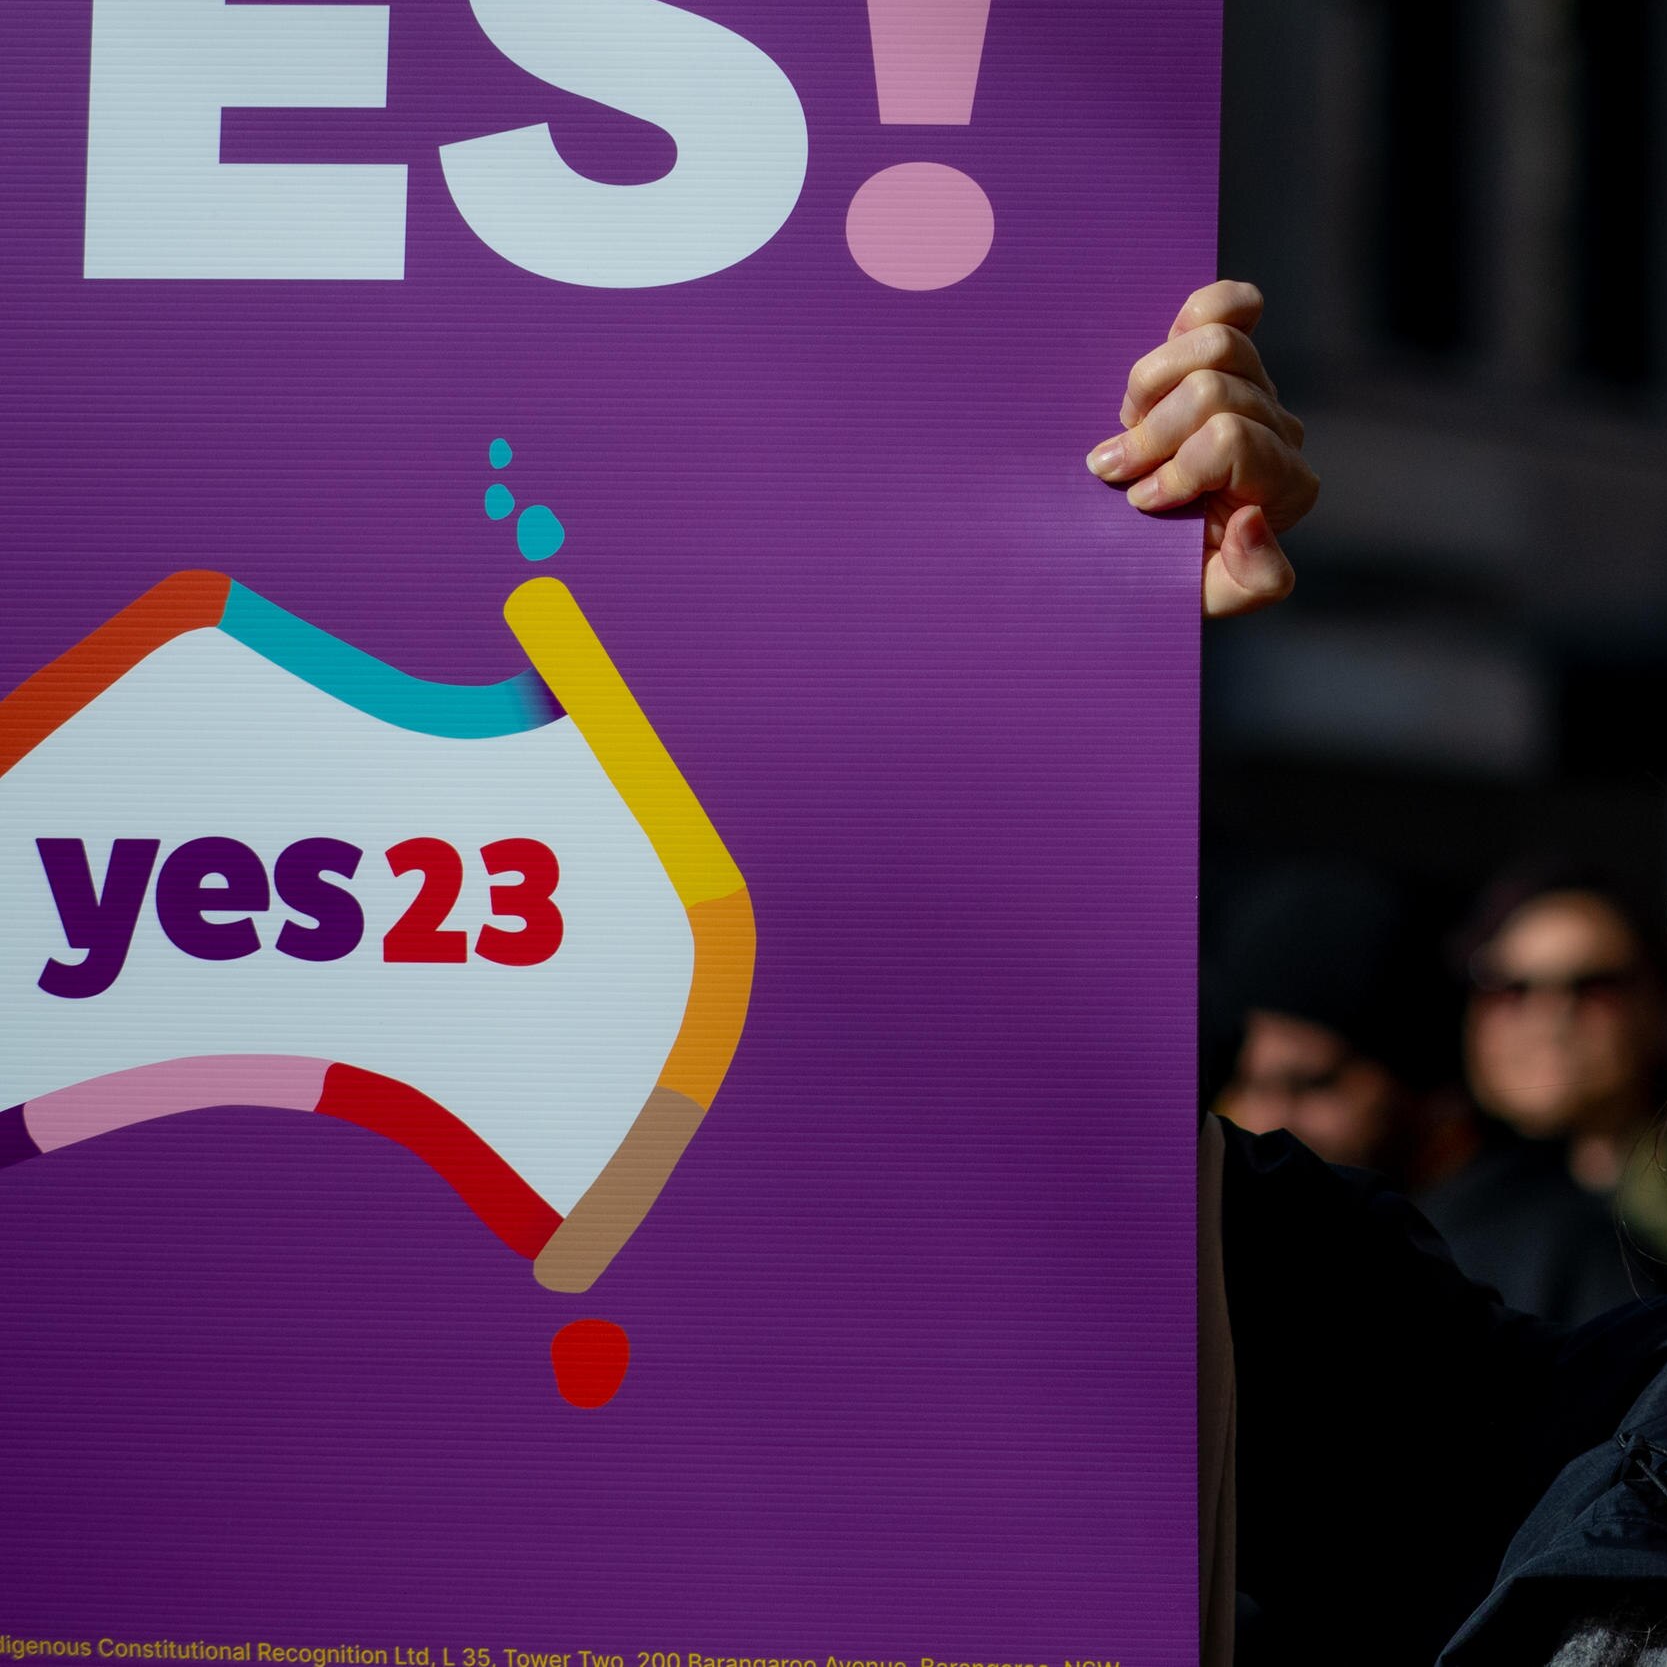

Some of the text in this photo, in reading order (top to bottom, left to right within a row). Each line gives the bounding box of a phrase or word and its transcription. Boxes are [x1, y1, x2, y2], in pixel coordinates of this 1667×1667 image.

[98, 1638, 251, 1661] Constitutional
[257, 1642, 388, 1667] Recognition
[395, 1646, 436, 1667] Ltd,
[443, 1647, 455, 1667] L
[503, 1648, 571, 1667] Tower
